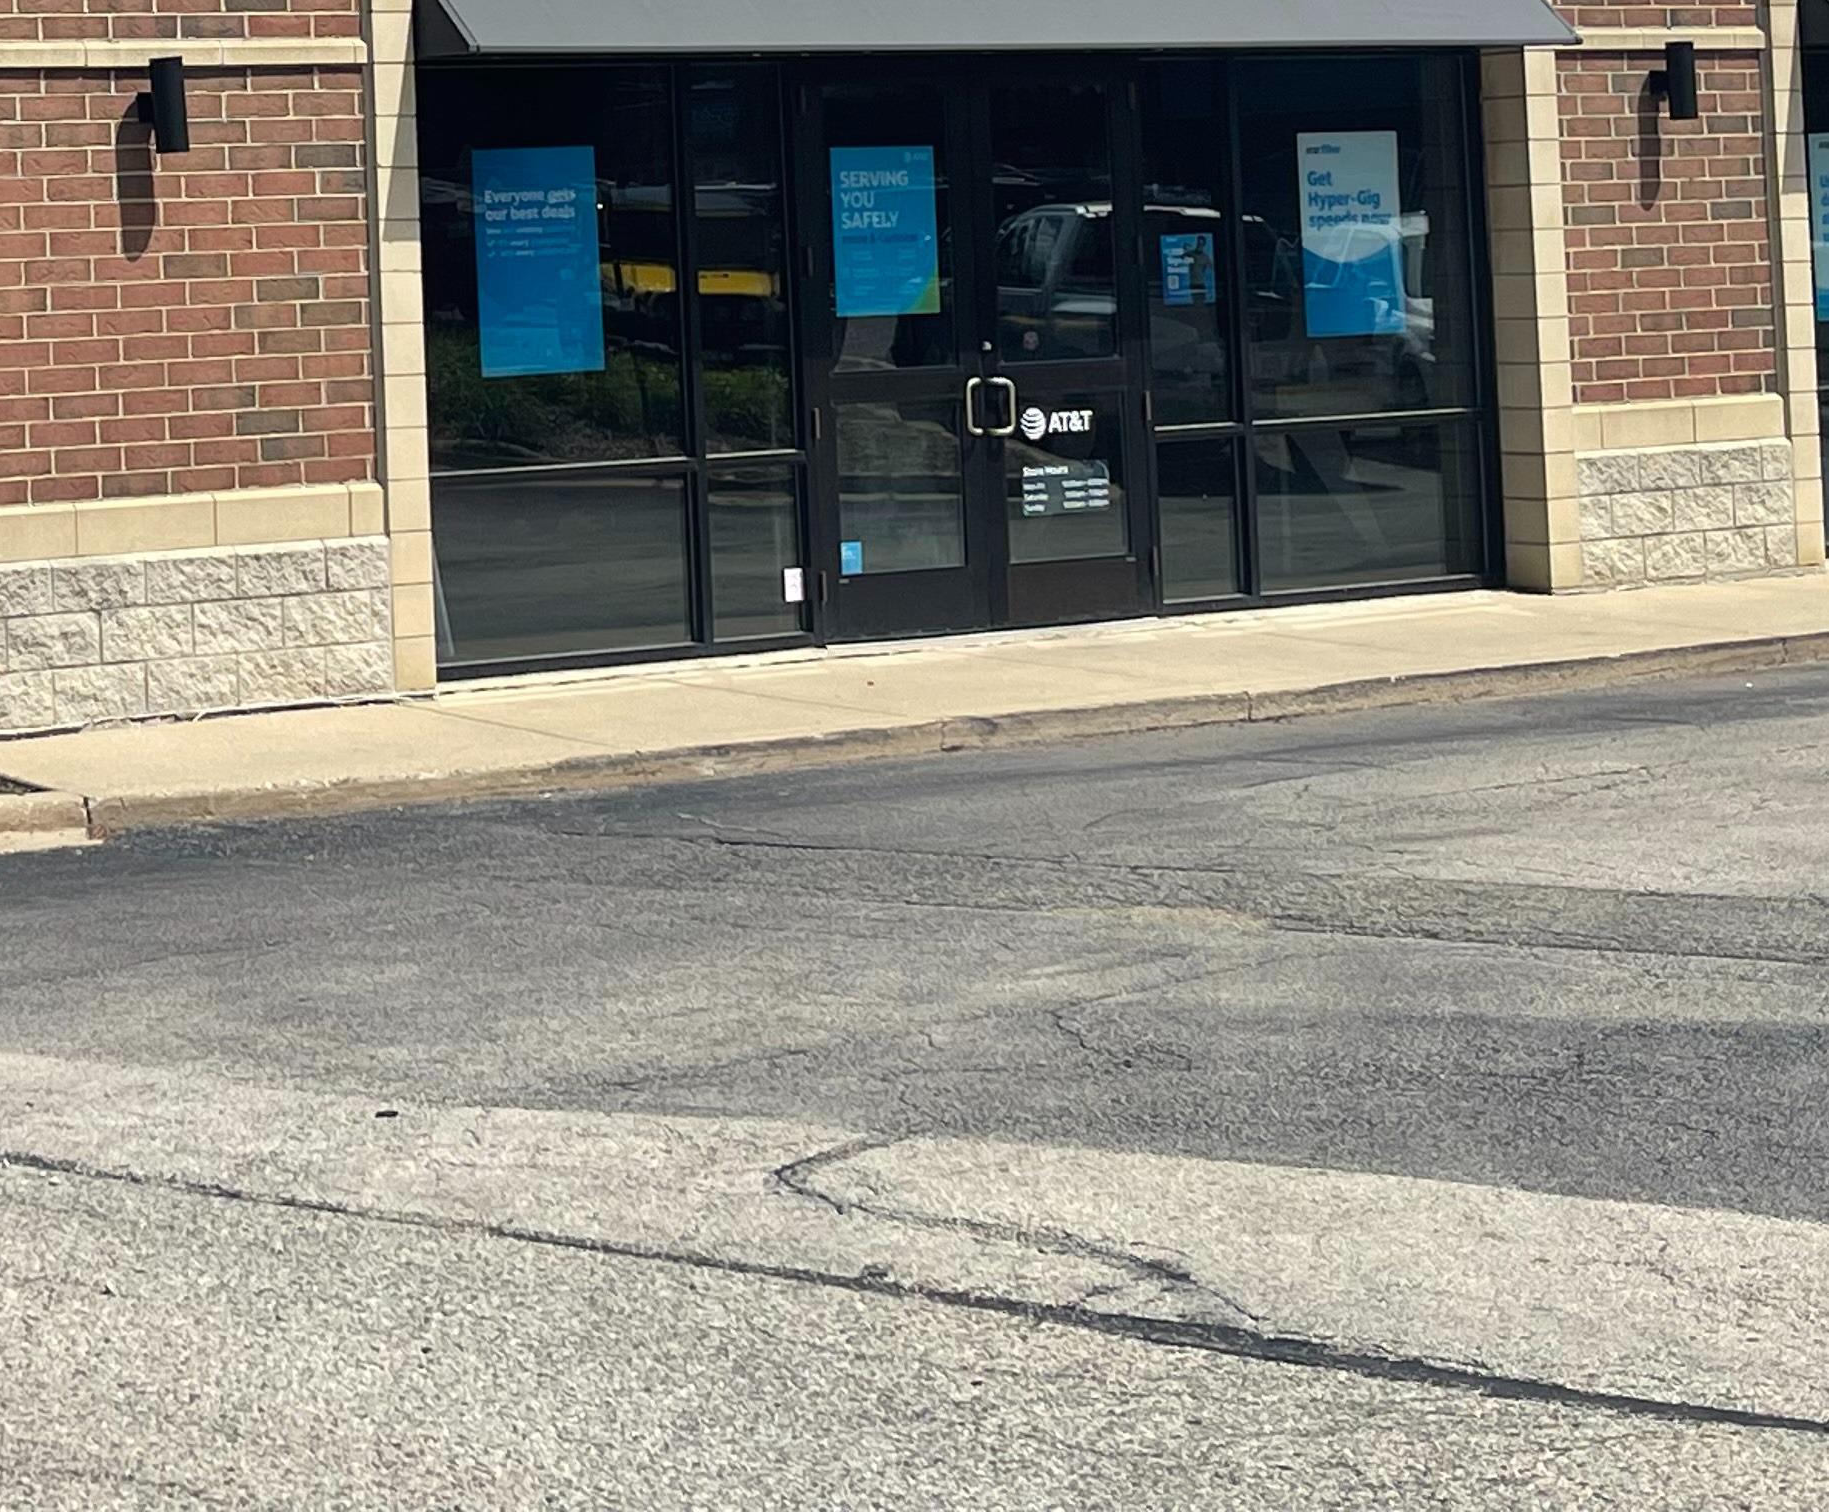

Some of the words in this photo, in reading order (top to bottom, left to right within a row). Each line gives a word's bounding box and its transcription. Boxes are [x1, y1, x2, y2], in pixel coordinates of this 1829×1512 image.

[839, 170, 909, 188] SERVING
[1306, 170, 1333, 187] Get
[483, 189, 545, 206] Everyone
[840, 190, 875, 208] YOU
[1307, 189, 1381, 212] Hyper-Gig
[484, 208, 508, 222] our
[510, 206, 540, 220] best
[542, 205, 576, 219] deals
[841, 211, 899, 230] SAFELY
[1308, 210, 1359, 231] speeds
[1048, 409, 1093, 434] AT&T
